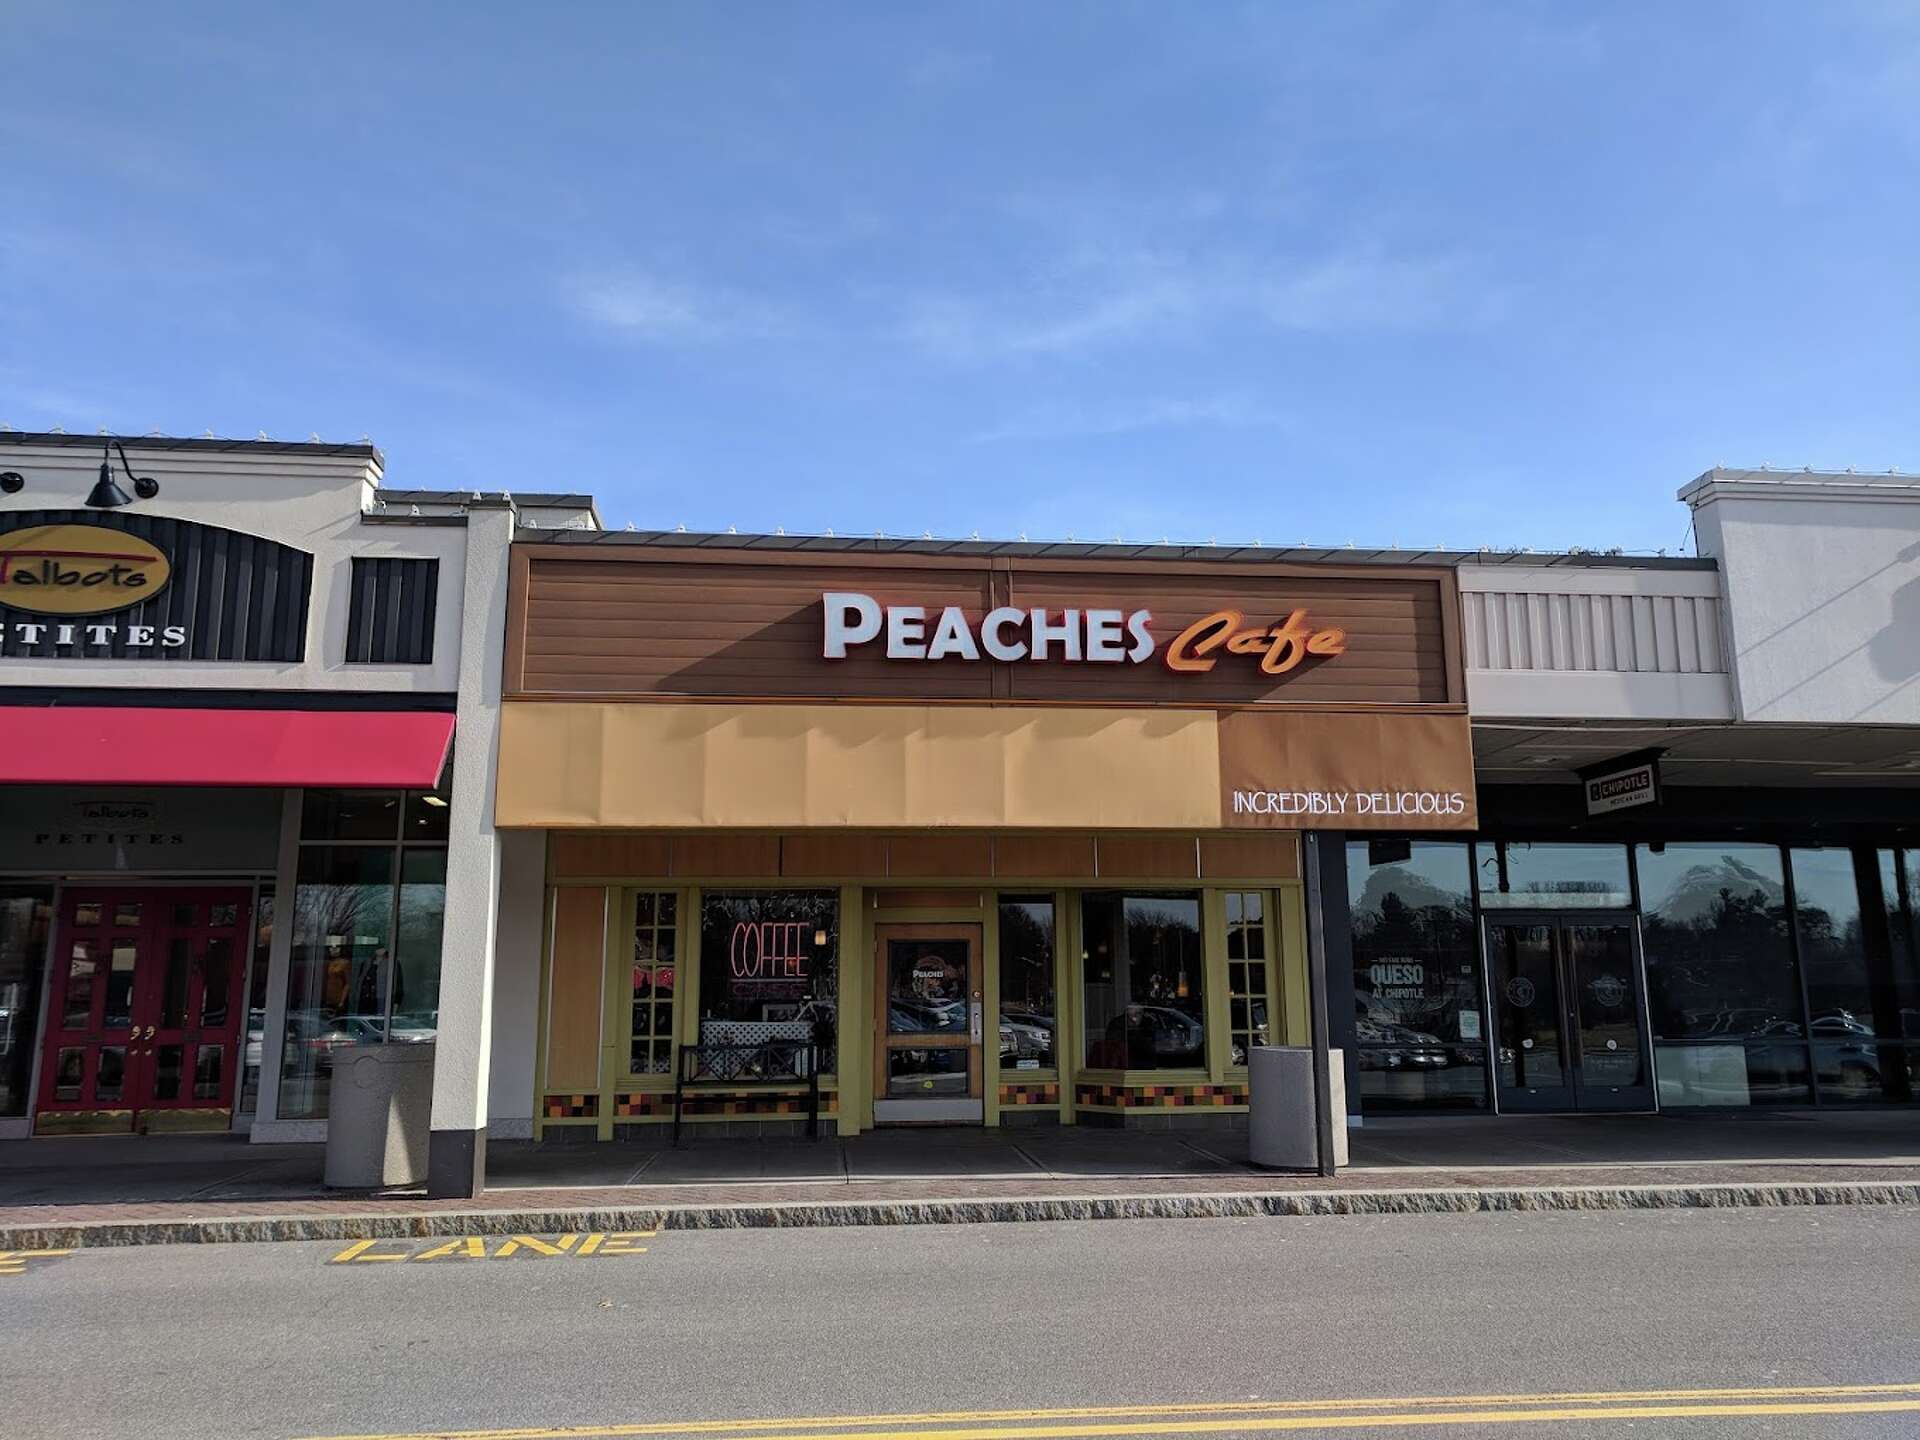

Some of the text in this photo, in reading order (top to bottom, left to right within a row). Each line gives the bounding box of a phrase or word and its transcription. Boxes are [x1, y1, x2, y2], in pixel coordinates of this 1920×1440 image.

[0, 624, 186, 647] TITES
[823, 592, 1345, 674] PEACHES Cafe
[1601, 773, 1648, 796] CHIPOTLE
[1233, 790, 1465, 815] INCREDIBLY DELICIOUS
[36, 833, 184, 845] PETITES
[730, 922, 810, 977] COFFEE
[1370, 964, 1424, 987] QUESO
[1385, 988, 1425, 999] CHIPOTLE
[333, 1231, 656, 1262] LANE
